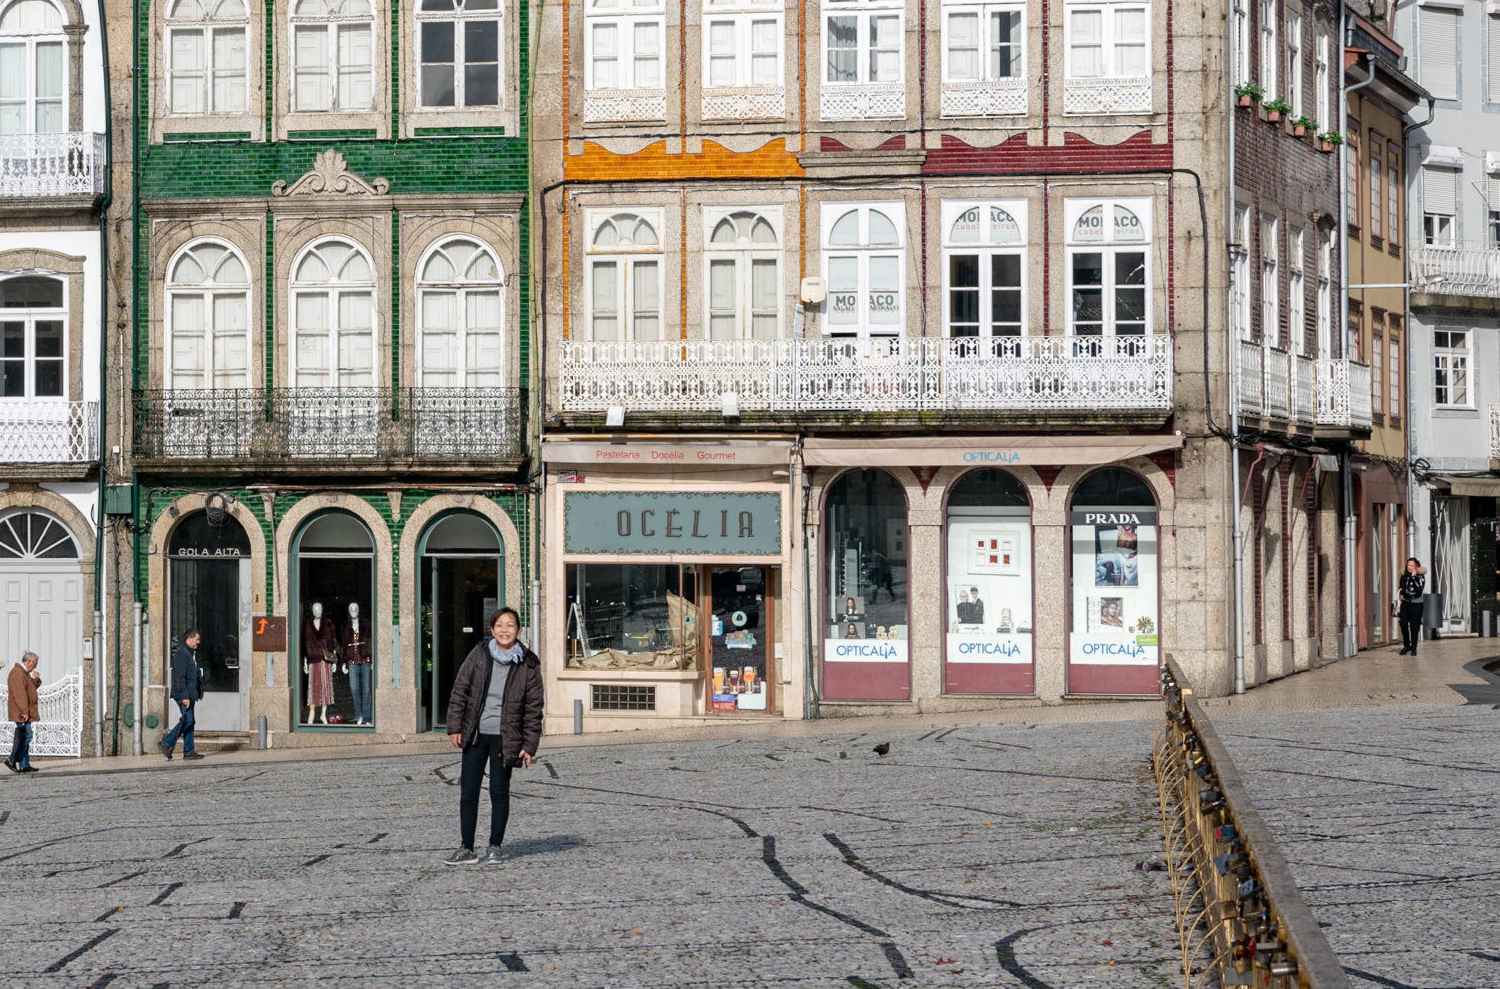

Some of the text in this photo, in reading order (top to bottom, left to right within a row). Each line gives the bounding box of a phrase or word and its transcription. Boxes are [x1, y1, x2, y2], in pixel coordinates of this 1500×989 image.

[957, 211, 1013, 222] MOACO
[1078, 216, 1139, 227] MOACO
[835, 295, 894, 306] MOACO
[596, 450, 736, 460] Pastelaria Docélia Gourmet
[617, 508, 754, 538] OCÉLIA
[1085, 513, 1141, 524] PRADA
[178, 547, 241, 557] GOLA ALTA
